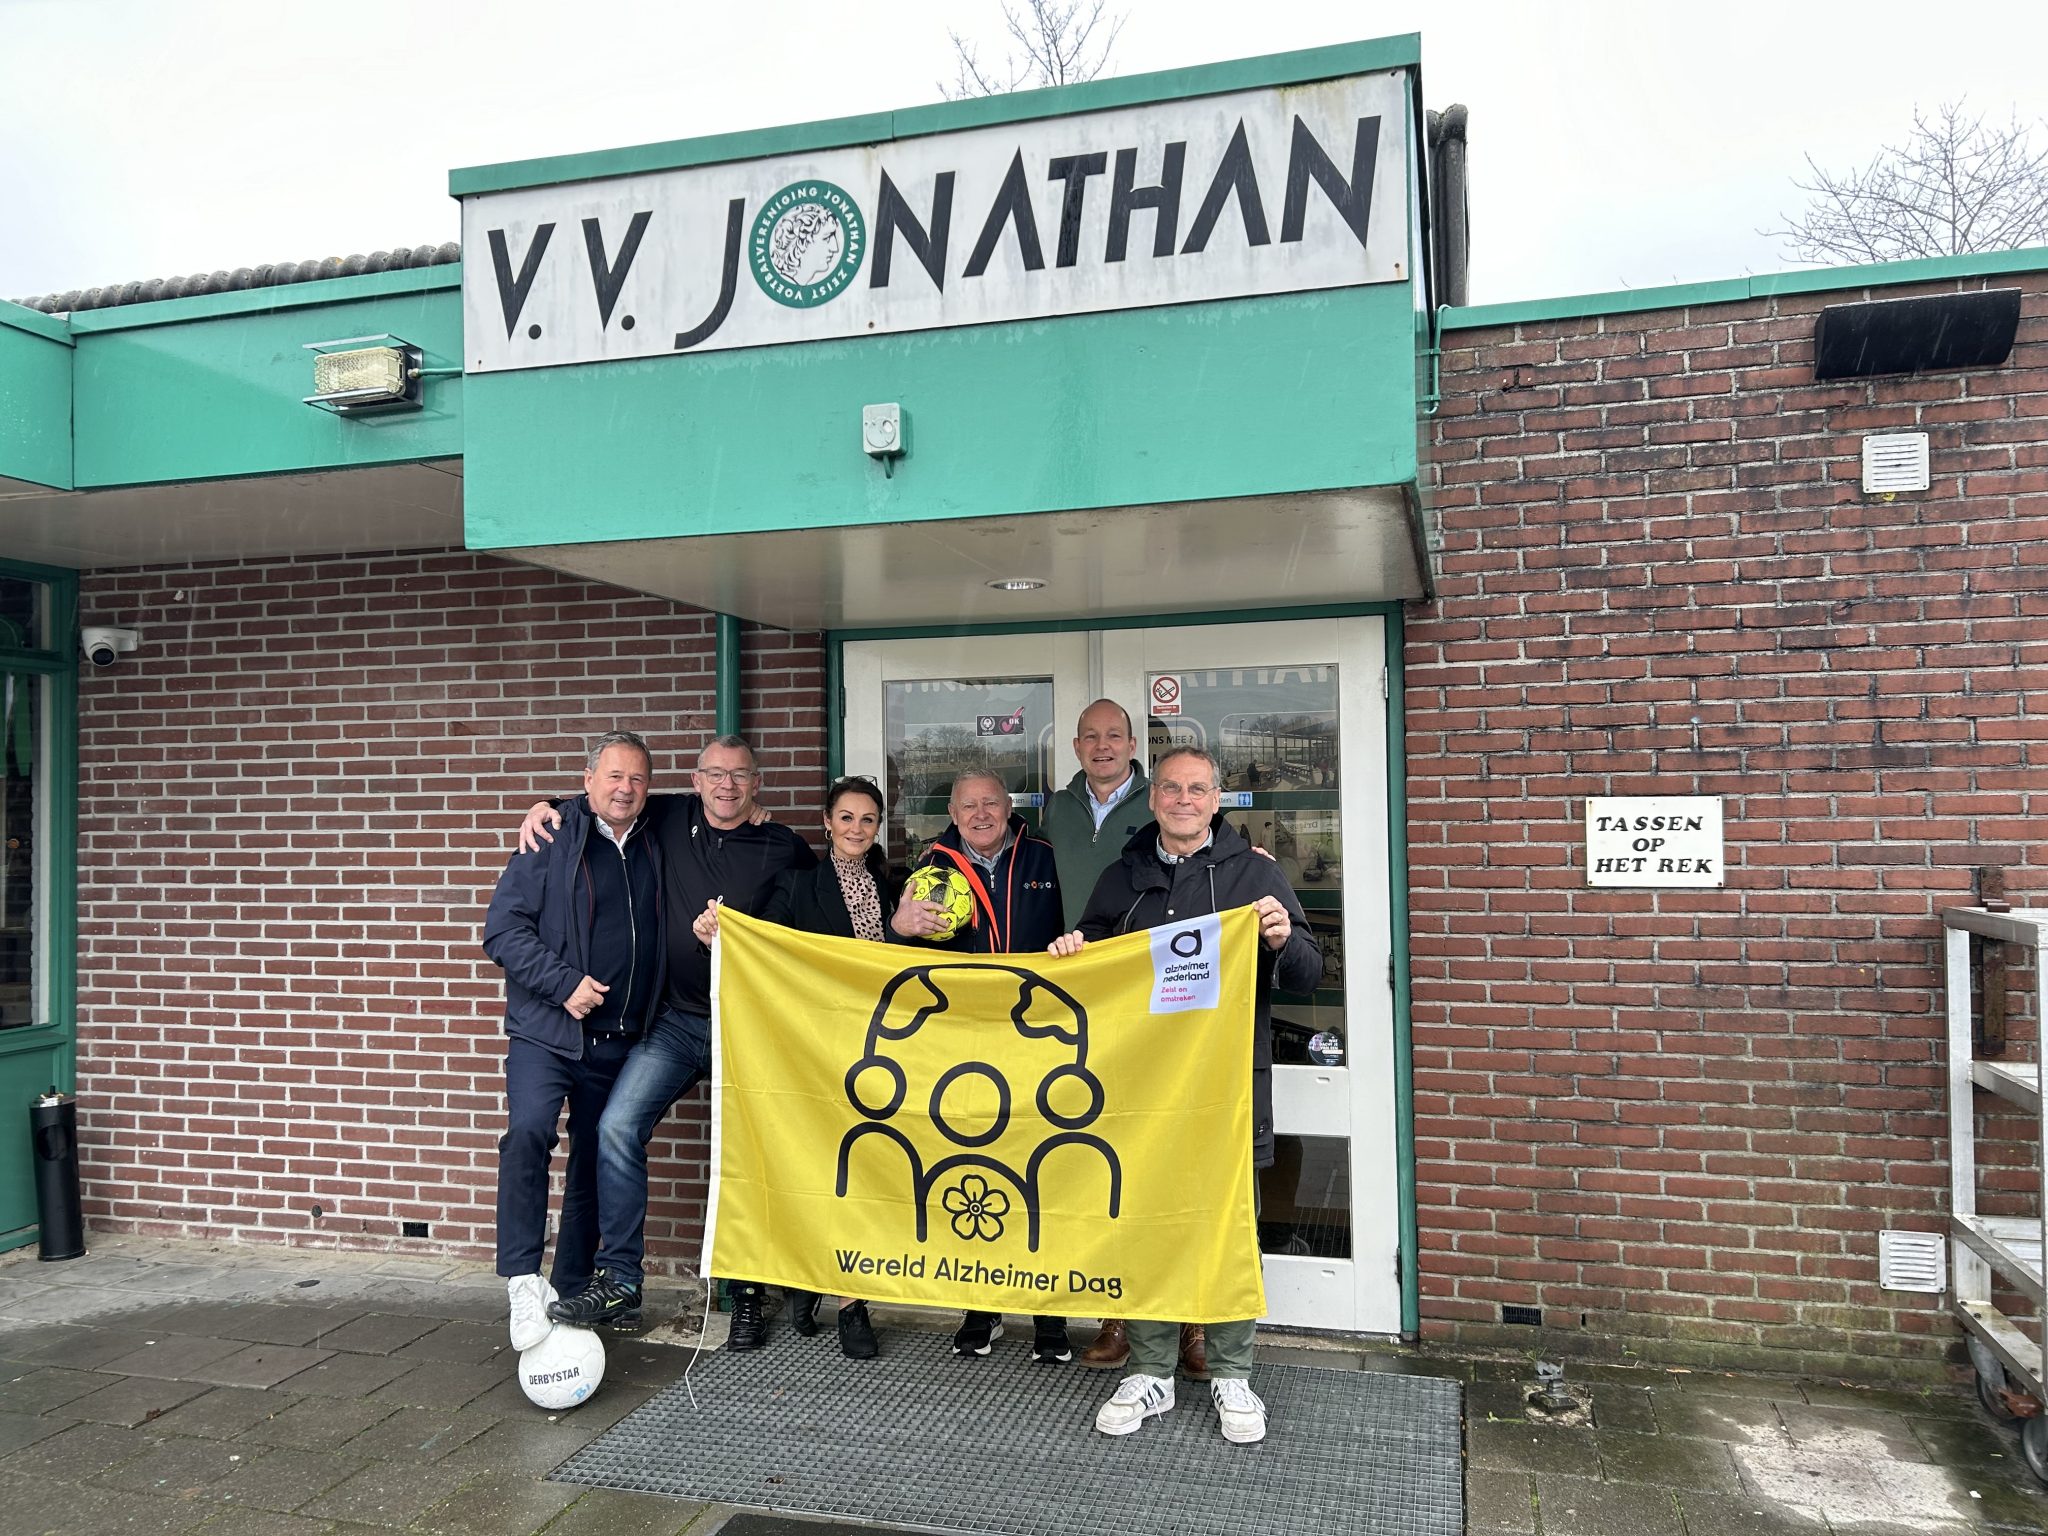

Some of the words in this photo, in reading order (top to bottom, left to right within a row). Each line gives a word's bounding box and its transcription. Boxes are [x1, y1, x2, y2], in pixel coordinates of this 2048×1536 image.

[674, 115, 1382, 349] JONATHAN
[824, 190, 859, 265] JONATHAN
[755, 186, 818, 301] VOETBALVERENIGING
[811, 267, 848, 299] ZEIST
[1166, 735, 1187, 745] MEE
[1596, 816, 1703, 832] TASSEN
[1632, 838, 1665, 852] OP
[1594, 857, 1648, 873] HET
[1657, 858, 1713, 873] REK
[1165, 961, 1210, 974] alzheimer
[1163, 971, 1210, 983] nederland
[1160, 994, 1196, 1002] omstreken
[835, 1249, 926, 1278] Wereld
[934, 1257, 1059, 1292] Alzheimer
[1069, 1270, 1123, 1299] Dag
[529, 1367, 580, 1385] DERBYSTAR
